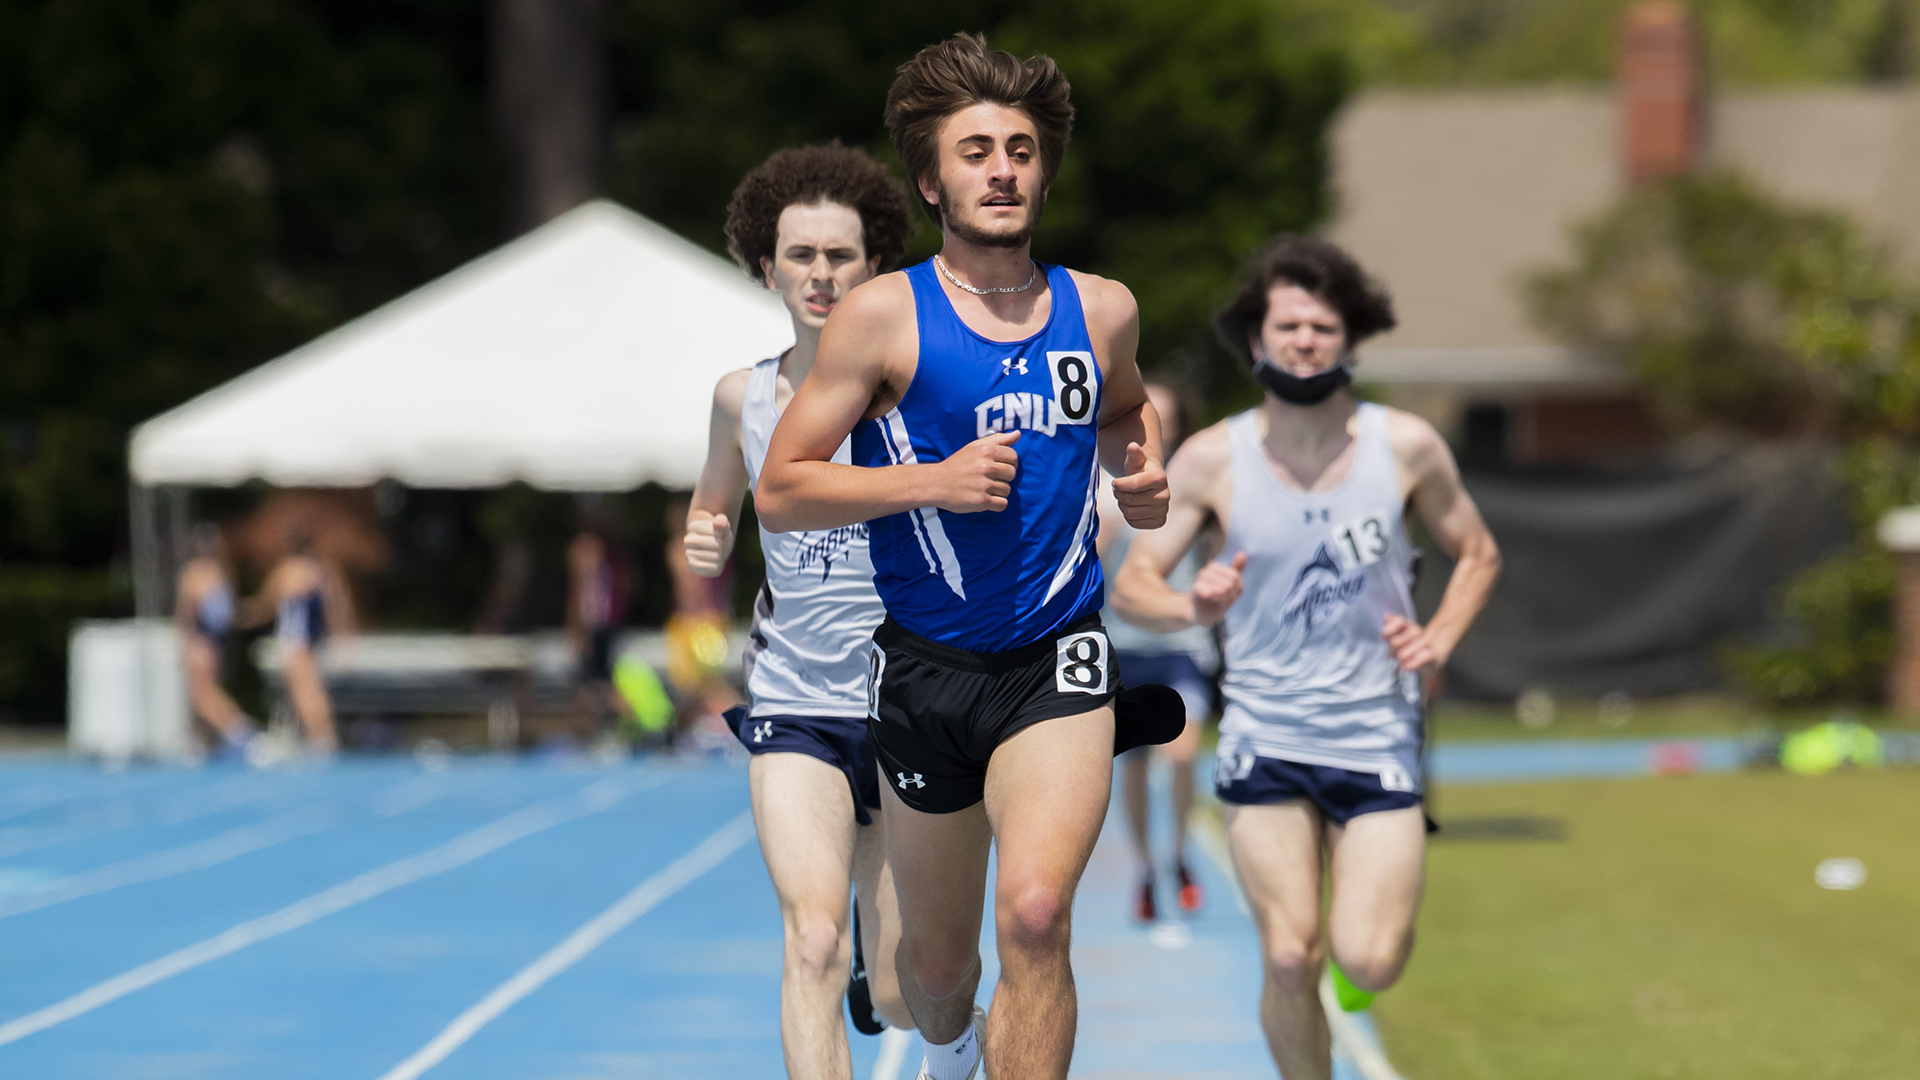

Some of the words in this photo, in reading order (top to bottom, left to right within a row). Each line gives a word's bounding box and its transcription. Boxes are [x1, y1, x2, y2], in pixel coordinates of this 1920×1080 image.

[1057, 356, 1091, 420] 8
[974, 392, 1058, 439] CNU
[1338, 517, 1389, 563] 13
[1063, 636, 1103, 690] 8
